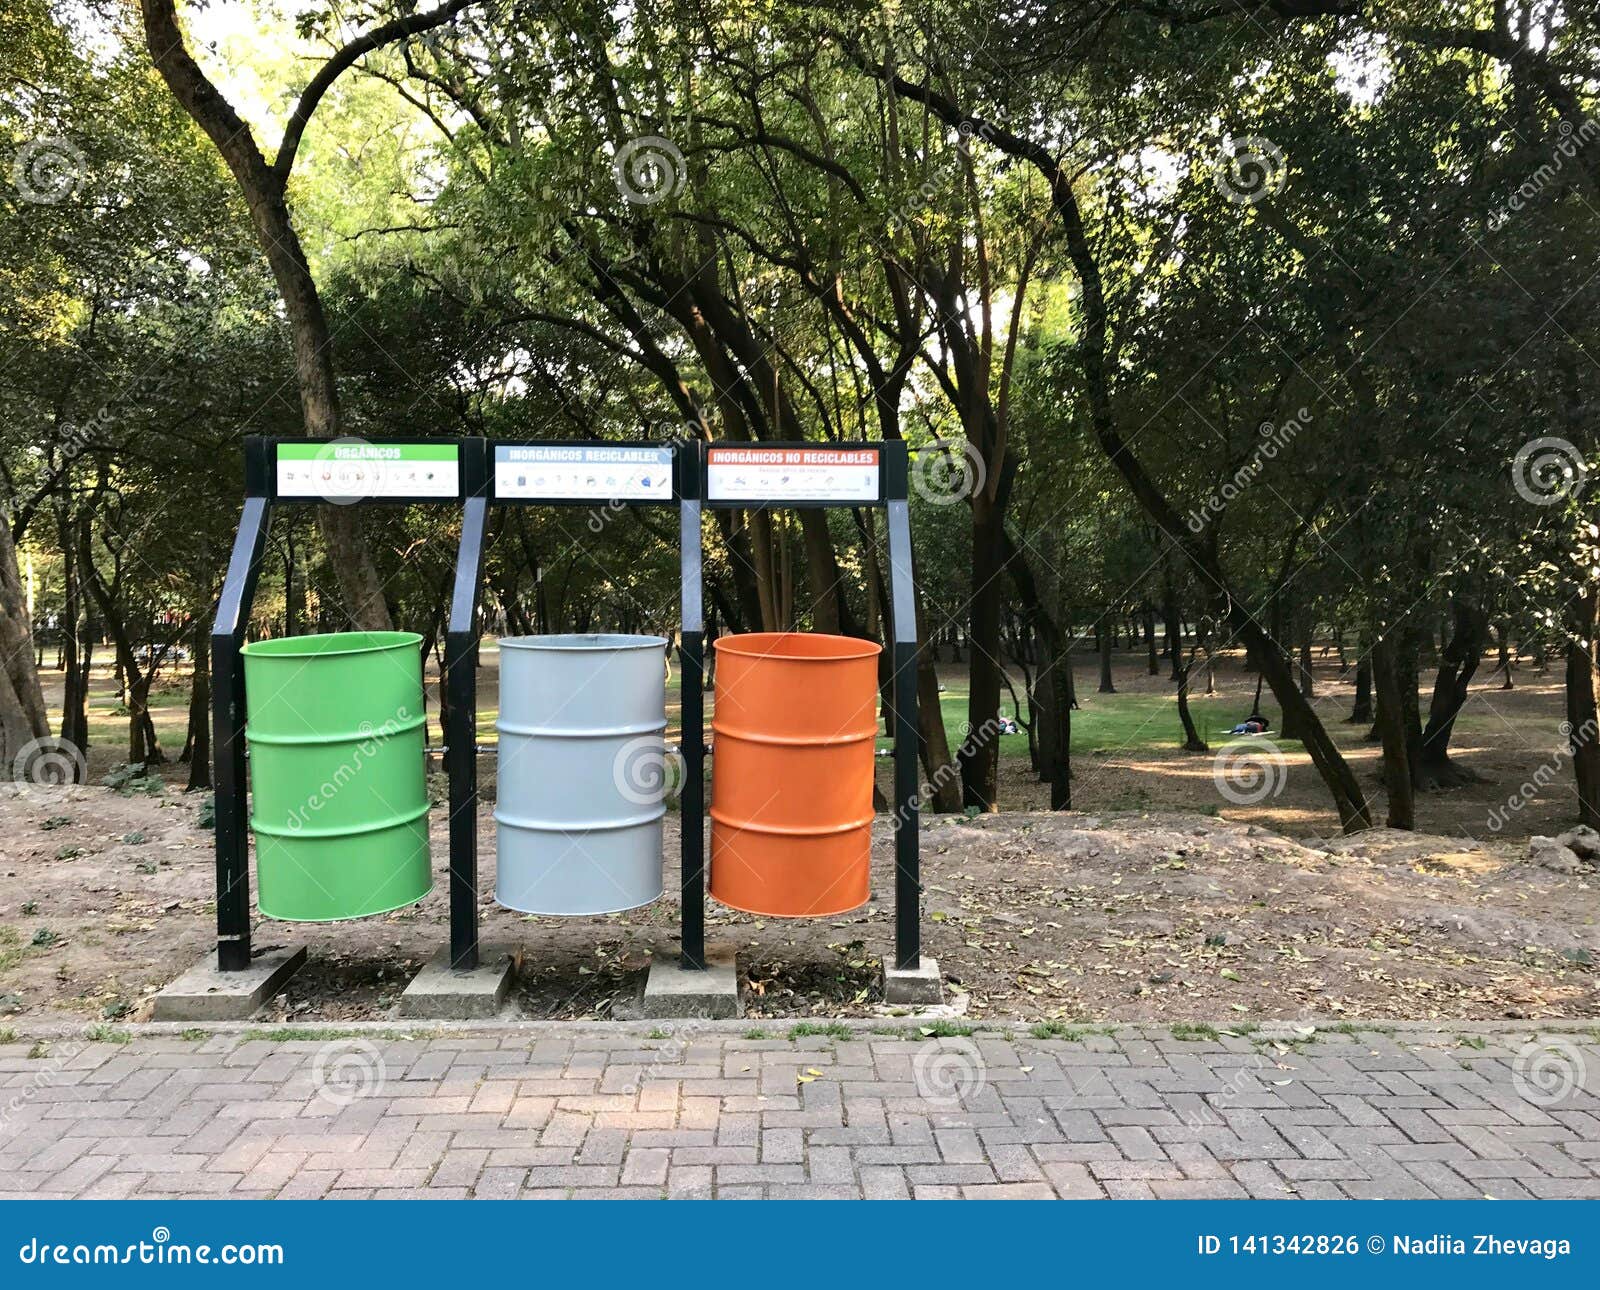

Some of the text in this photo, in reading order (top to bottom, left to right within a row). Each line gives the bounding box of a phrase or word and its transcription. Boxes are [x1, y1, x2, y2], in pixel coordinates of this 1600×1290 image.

[509, 448, 659, 463] INORGÁNICOS RECICLABLES
[713, 450, 874, 464] INORGÁNICOS NO RECICLABLES
